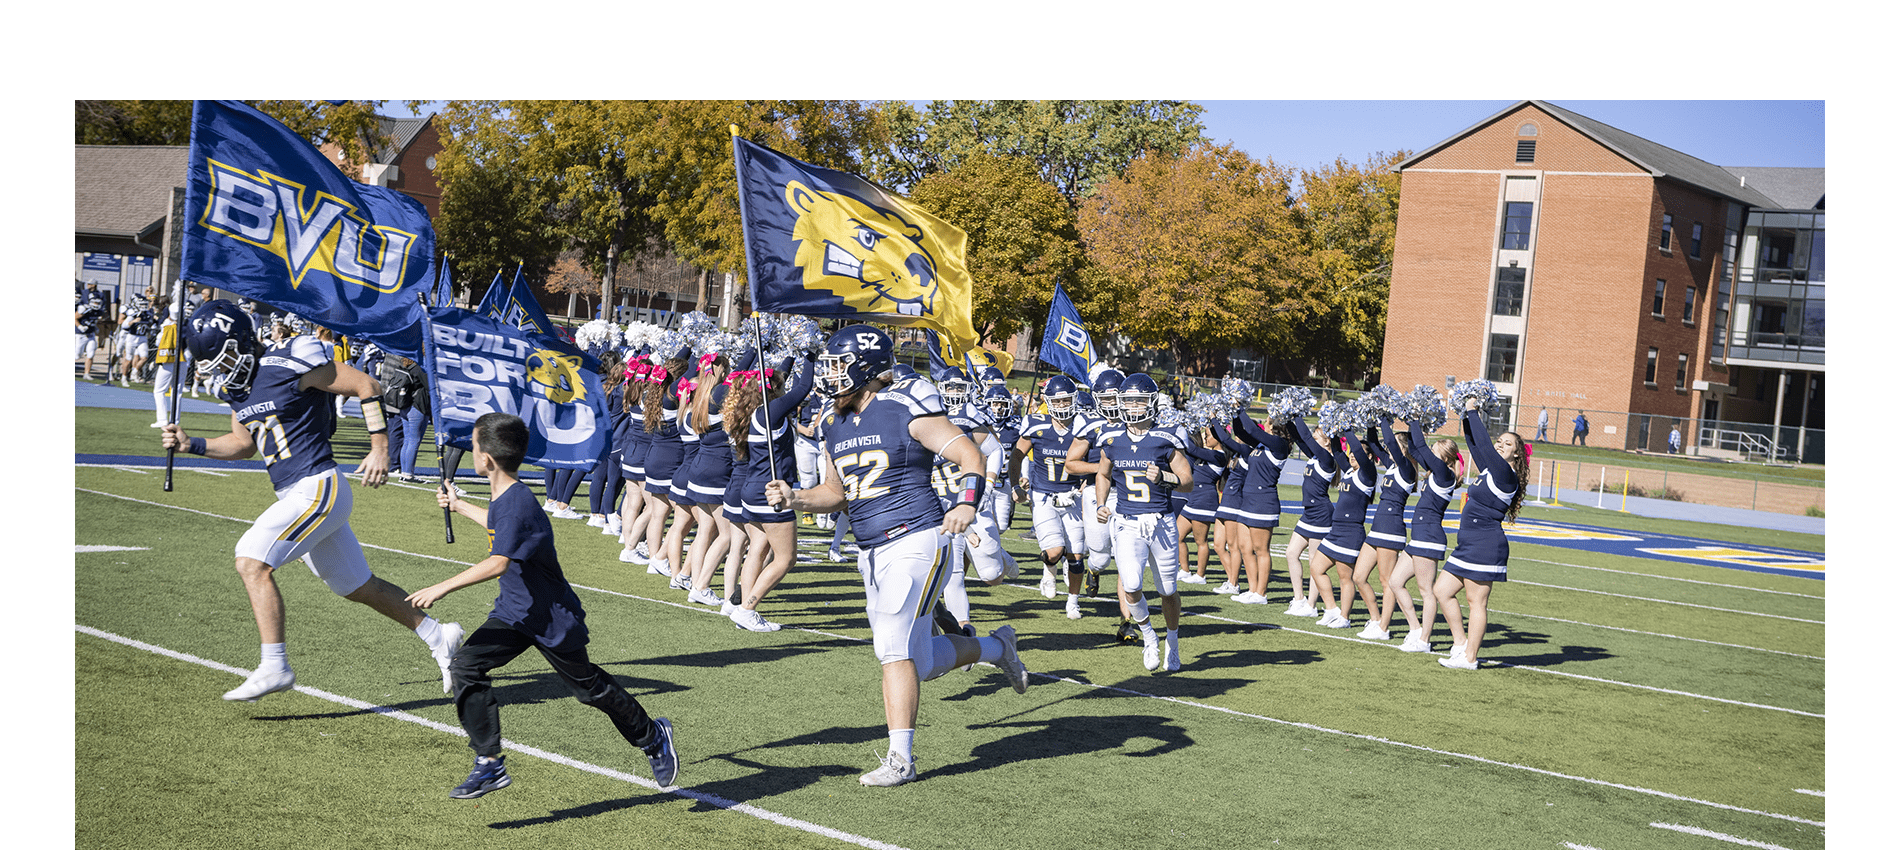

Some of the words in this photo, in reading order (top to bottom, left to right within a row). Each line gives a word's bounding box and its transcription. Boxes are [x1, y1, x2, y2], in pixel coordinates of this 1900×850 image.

[203, 163, 413, 290] BVU
[210, 312, 235, 334] 21
[432, 324, 531, 359] BUILT
[855, 332, 881, 350] 52
[435, 348, 526, 390] FOR
[438, 379, 597, 445] BVU
[244, 414, 292, 467] 21
[834, 438, 858, 454] BUENA
[858, 434, 882, 447] VISTA
[1042, 447, 1062, 457] BUENA
[834, 449, 891, 502] 52
[930, 461, 963, 497] 48
[1114, 460, 1136, 468] BUENA
[1122, 470, 1151, 503] 5
